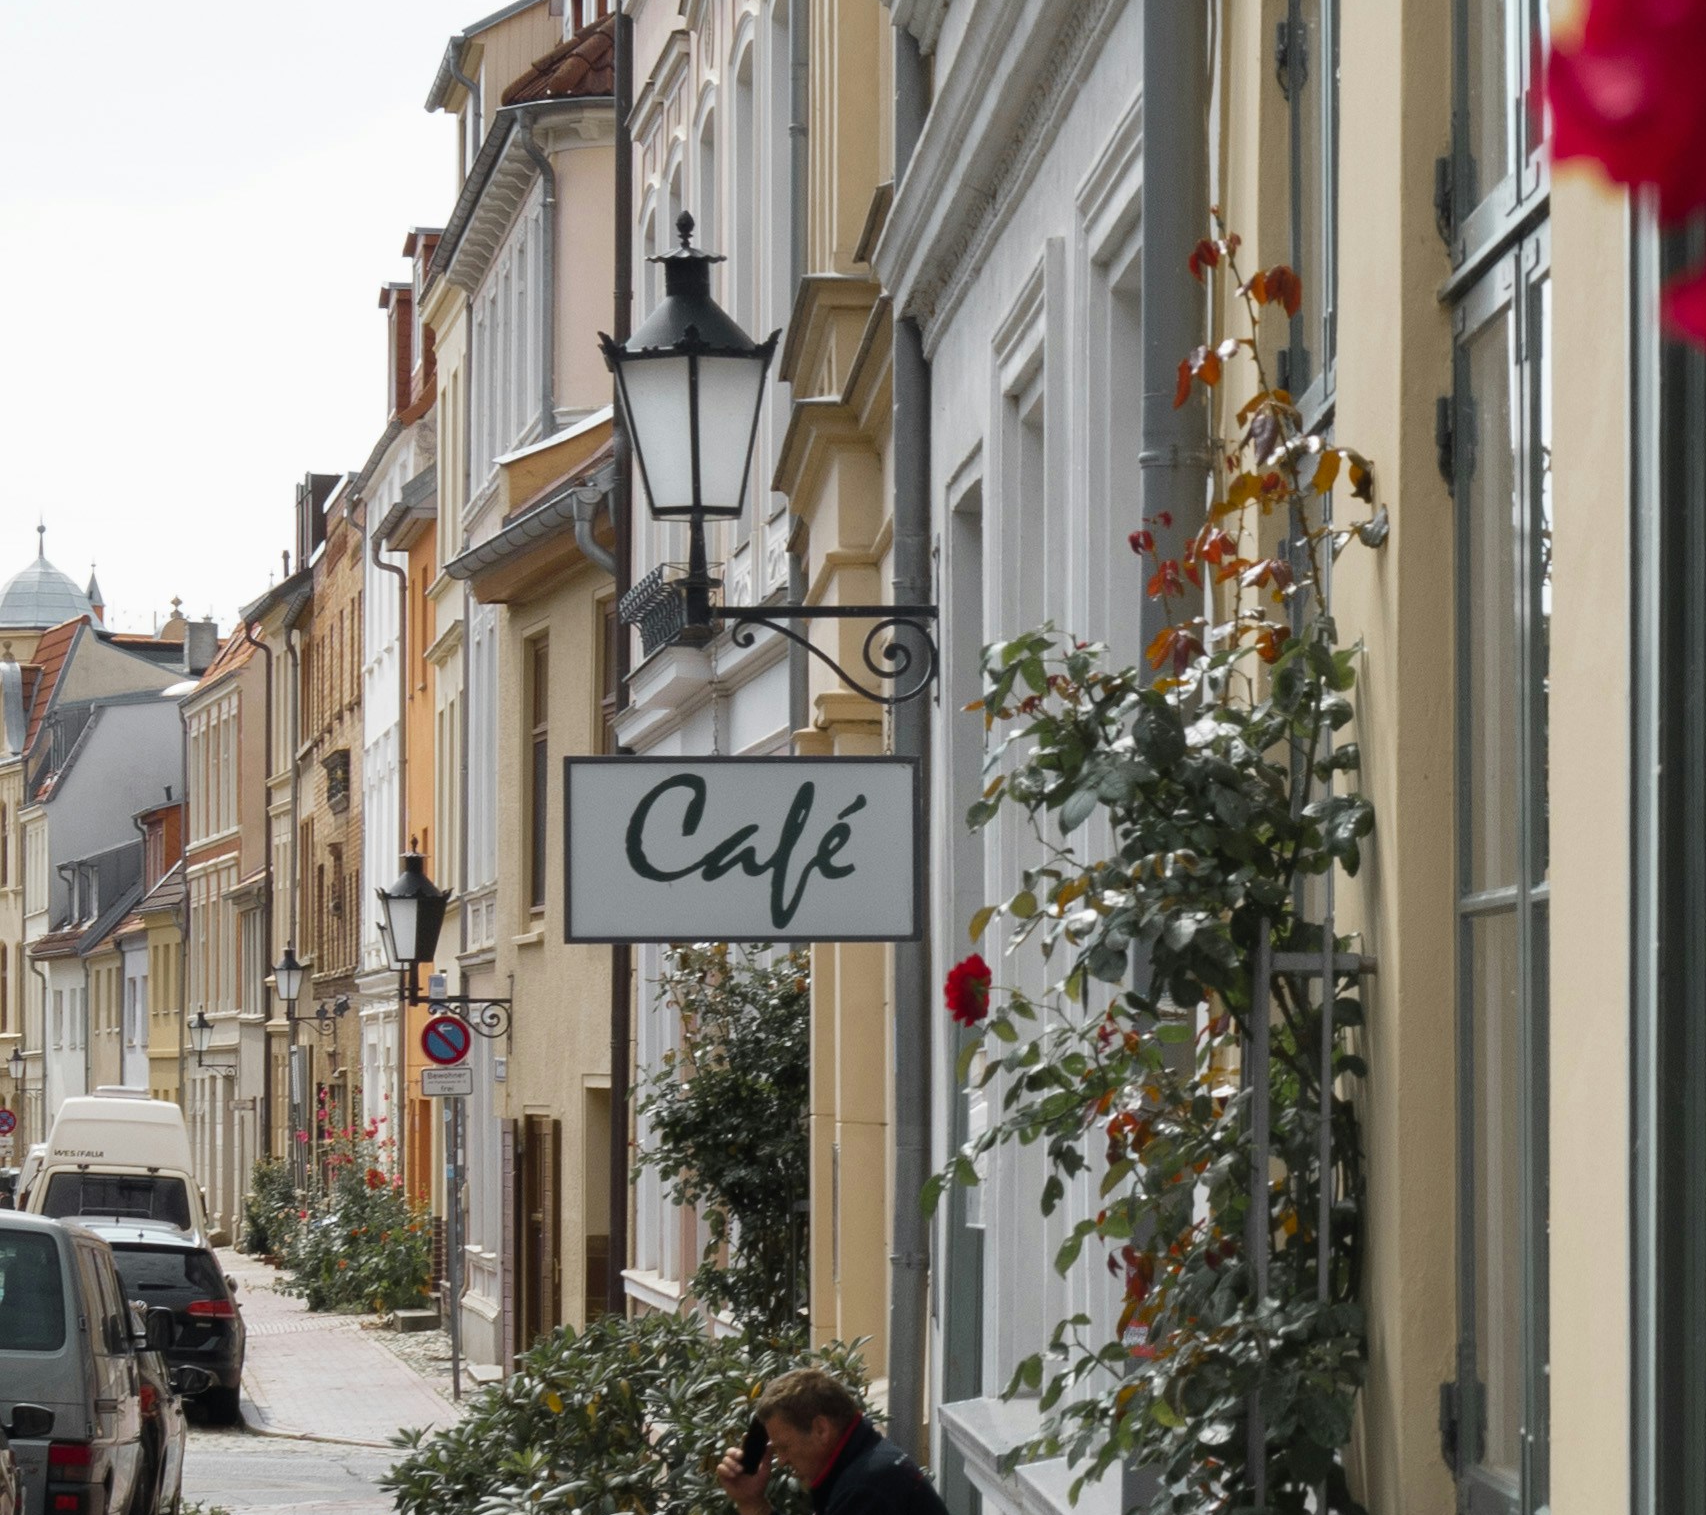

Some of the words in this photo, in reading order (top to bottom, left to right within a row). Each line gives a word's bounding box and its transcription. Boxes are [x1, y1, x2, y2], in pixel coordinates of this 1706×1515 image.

[626, 773, 867, 929] Café
[427, 1071, 467, 1079] Bewohner
[54, 1149, 104, 1158] WESTFALIA
